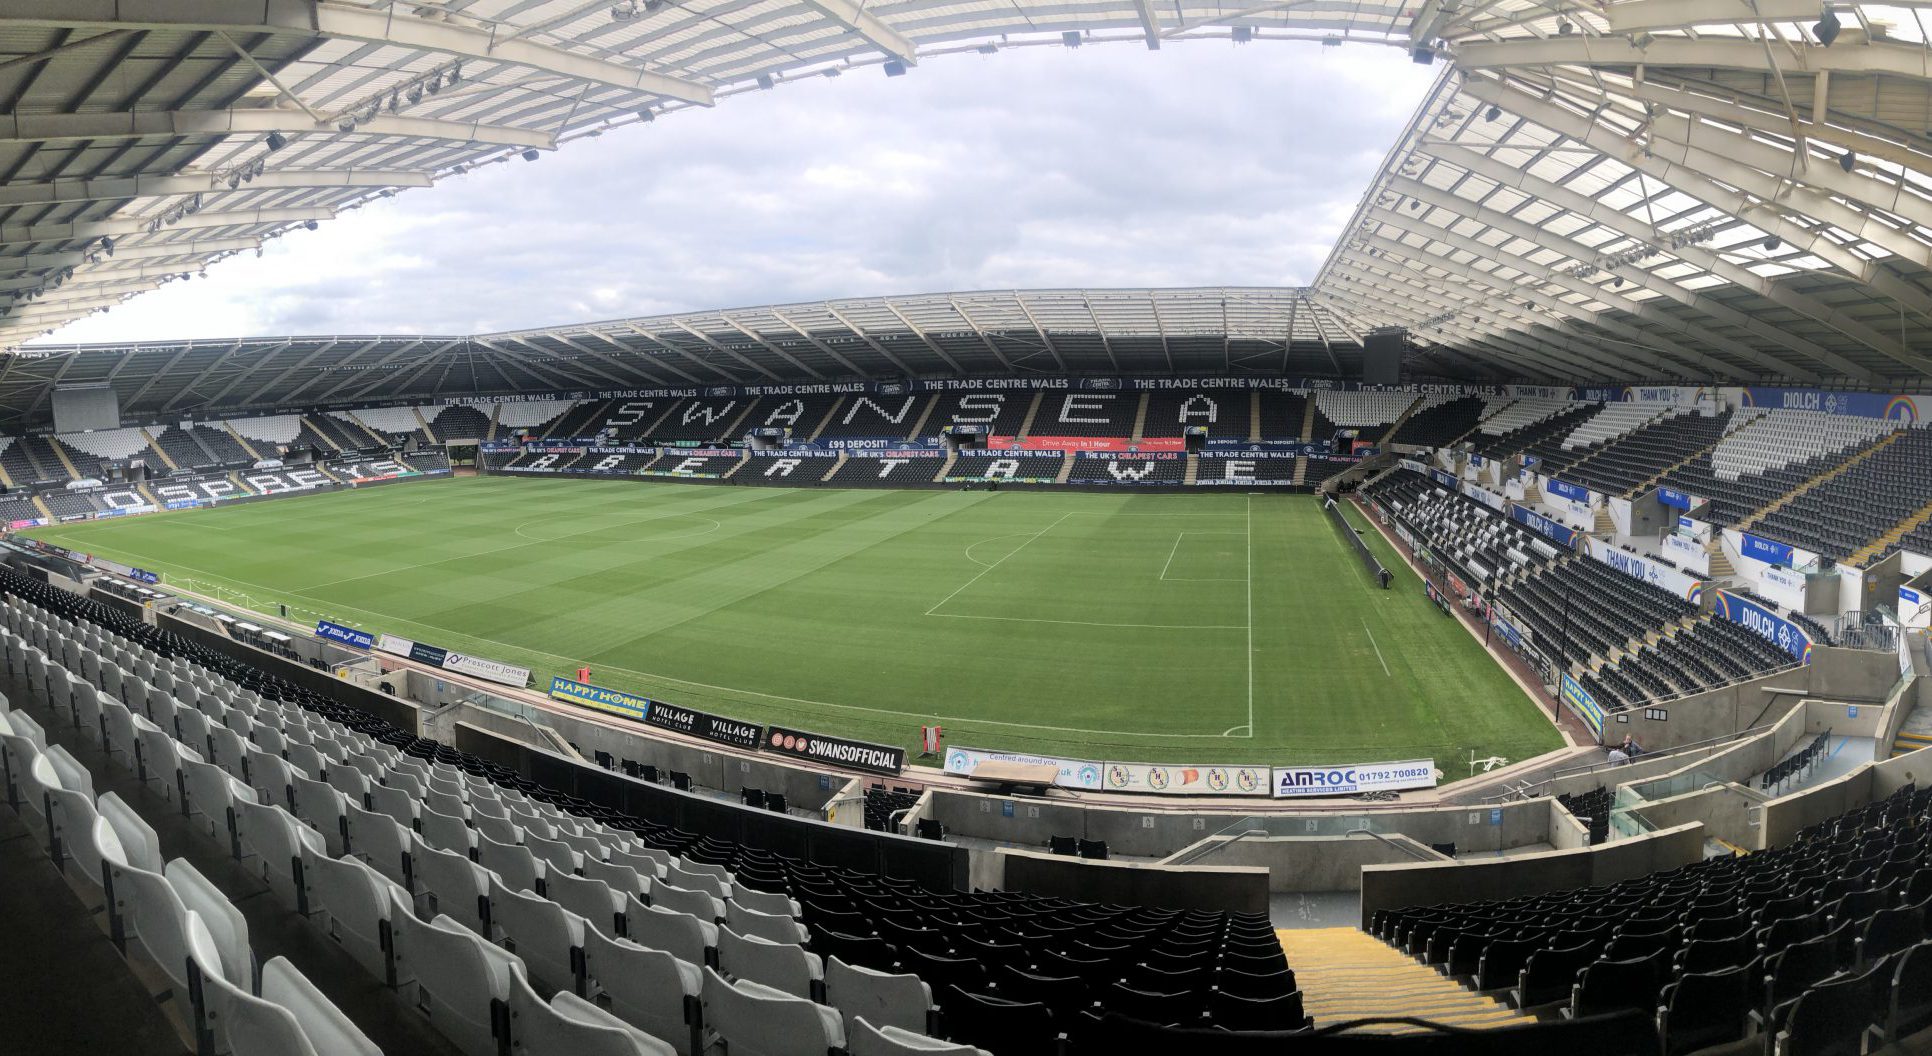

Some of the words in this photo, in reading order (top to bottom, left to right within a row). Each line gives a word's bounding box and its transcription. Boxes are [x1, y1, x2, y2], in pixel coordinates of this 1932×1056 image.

[745, 387, 761, 395] THE
[763, 386, 792, 394] TRADE
[795, 384, 831, 394] CENTRE
[832, 383, 865, 393] WALES
[924, 381, 944, 390] THE
[947, 380, 984, 389] TRADE
[986, 379, 1027, 388] CENTRE
[1030, 379, 1069, 389] WALES
[1134, 379, 1156, 389] THE
[1159, 379, 1198, 389] TRADE
[1200, 379, 1245, 389] CENTRE
[1248, 379, 1289, 388] WALES
[1516, 386, 1537, 396] THANK
[1538, 386, 1549, 396] YOU
[463, 396, 492, 405] TRADE
[494, 395, 526, 403] CENTRE
[599, 391, 612, 399] THE
[613, 390, 637, 398] TRADE
[639, 390, 669, 398] CENTRE
[670, 389, 697, 397] WALES
[1640, 388, 1658, 400] THANK
[1659, 388, 1671, 400] YOU
[1783, 391, 1820, 410] DIOLCH
[606, 394, 1218, 426] SWANSEA
[828, 440, 845, 449] £99
[847, 440, 888, 448] DEPOSIT!
[1062, 440, 1079, 448] Away
[1094, 440, 1111, 448] Hour
[1034, 450, 1061, 458] WALES
[1157, 452, 1178, 460] CARS
[1606, 548, 1629, 573] THANK
[1631, 558, 1646, 579] YOU
[1742, 606, 1775, 641] DIOLCH
[462, 656, 500, 671] Prescott
[502, 666, 527, 677] Jones
[554, 680, 599, 698] HAPPY
[599, 691, 647, 709] HOME
[654, 705, 695, 725] VILLAGE
[652, 715, 672, 726] HOTEL
[674, 722, 692, 731] CLUB
[711, 719, 756, 739] VILLAGE
[709, 731, 731, 741] HOTEL
[734, 736, 753, 745] CLUB
[808, 739, 896, 769] SWANSOFFICIAL
[989, 753, 1017, 762] Centred
[1017, 756, 1042, 764] around
[1043, 758, 1057, 766] you
[1280, 770, 1356, 787] AMROC
[1359, 771, 1390, 782] 01792
[1392, 767, 1429, 779] 700820
